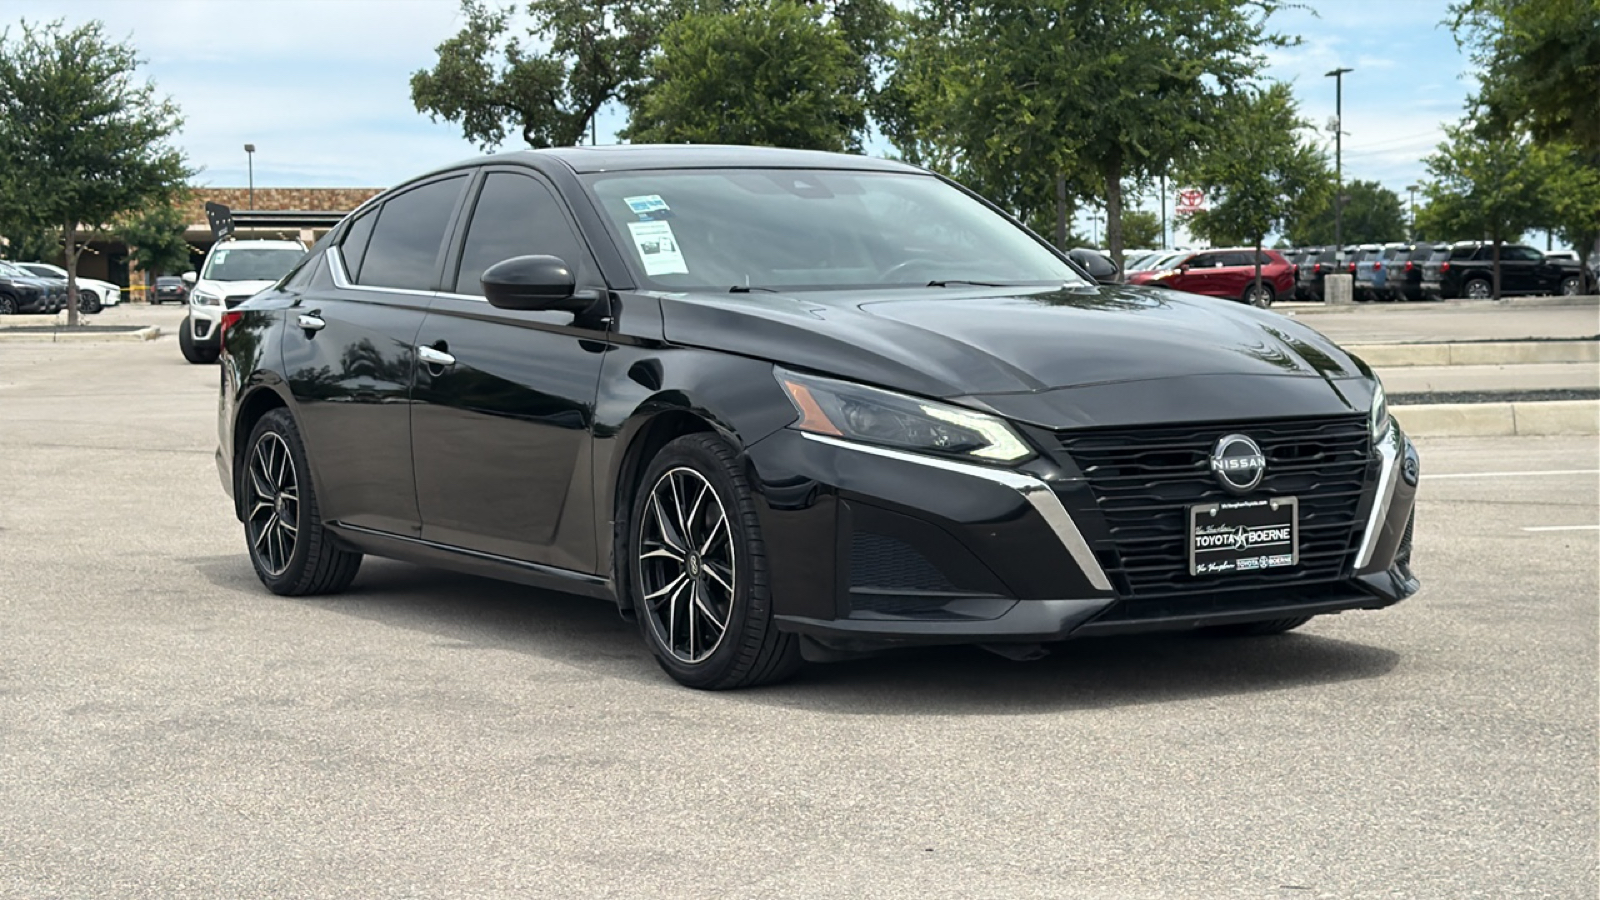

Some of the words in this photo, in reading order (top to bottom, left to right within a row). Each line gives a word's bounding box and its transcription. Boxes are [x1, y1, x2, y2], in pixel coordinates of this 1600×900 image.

[1213, 458, 1265, 470] NISSAN
[1196, 534, 1235, 547] TOYOTA
[1248, 529, 1290, 542] BOERNE
